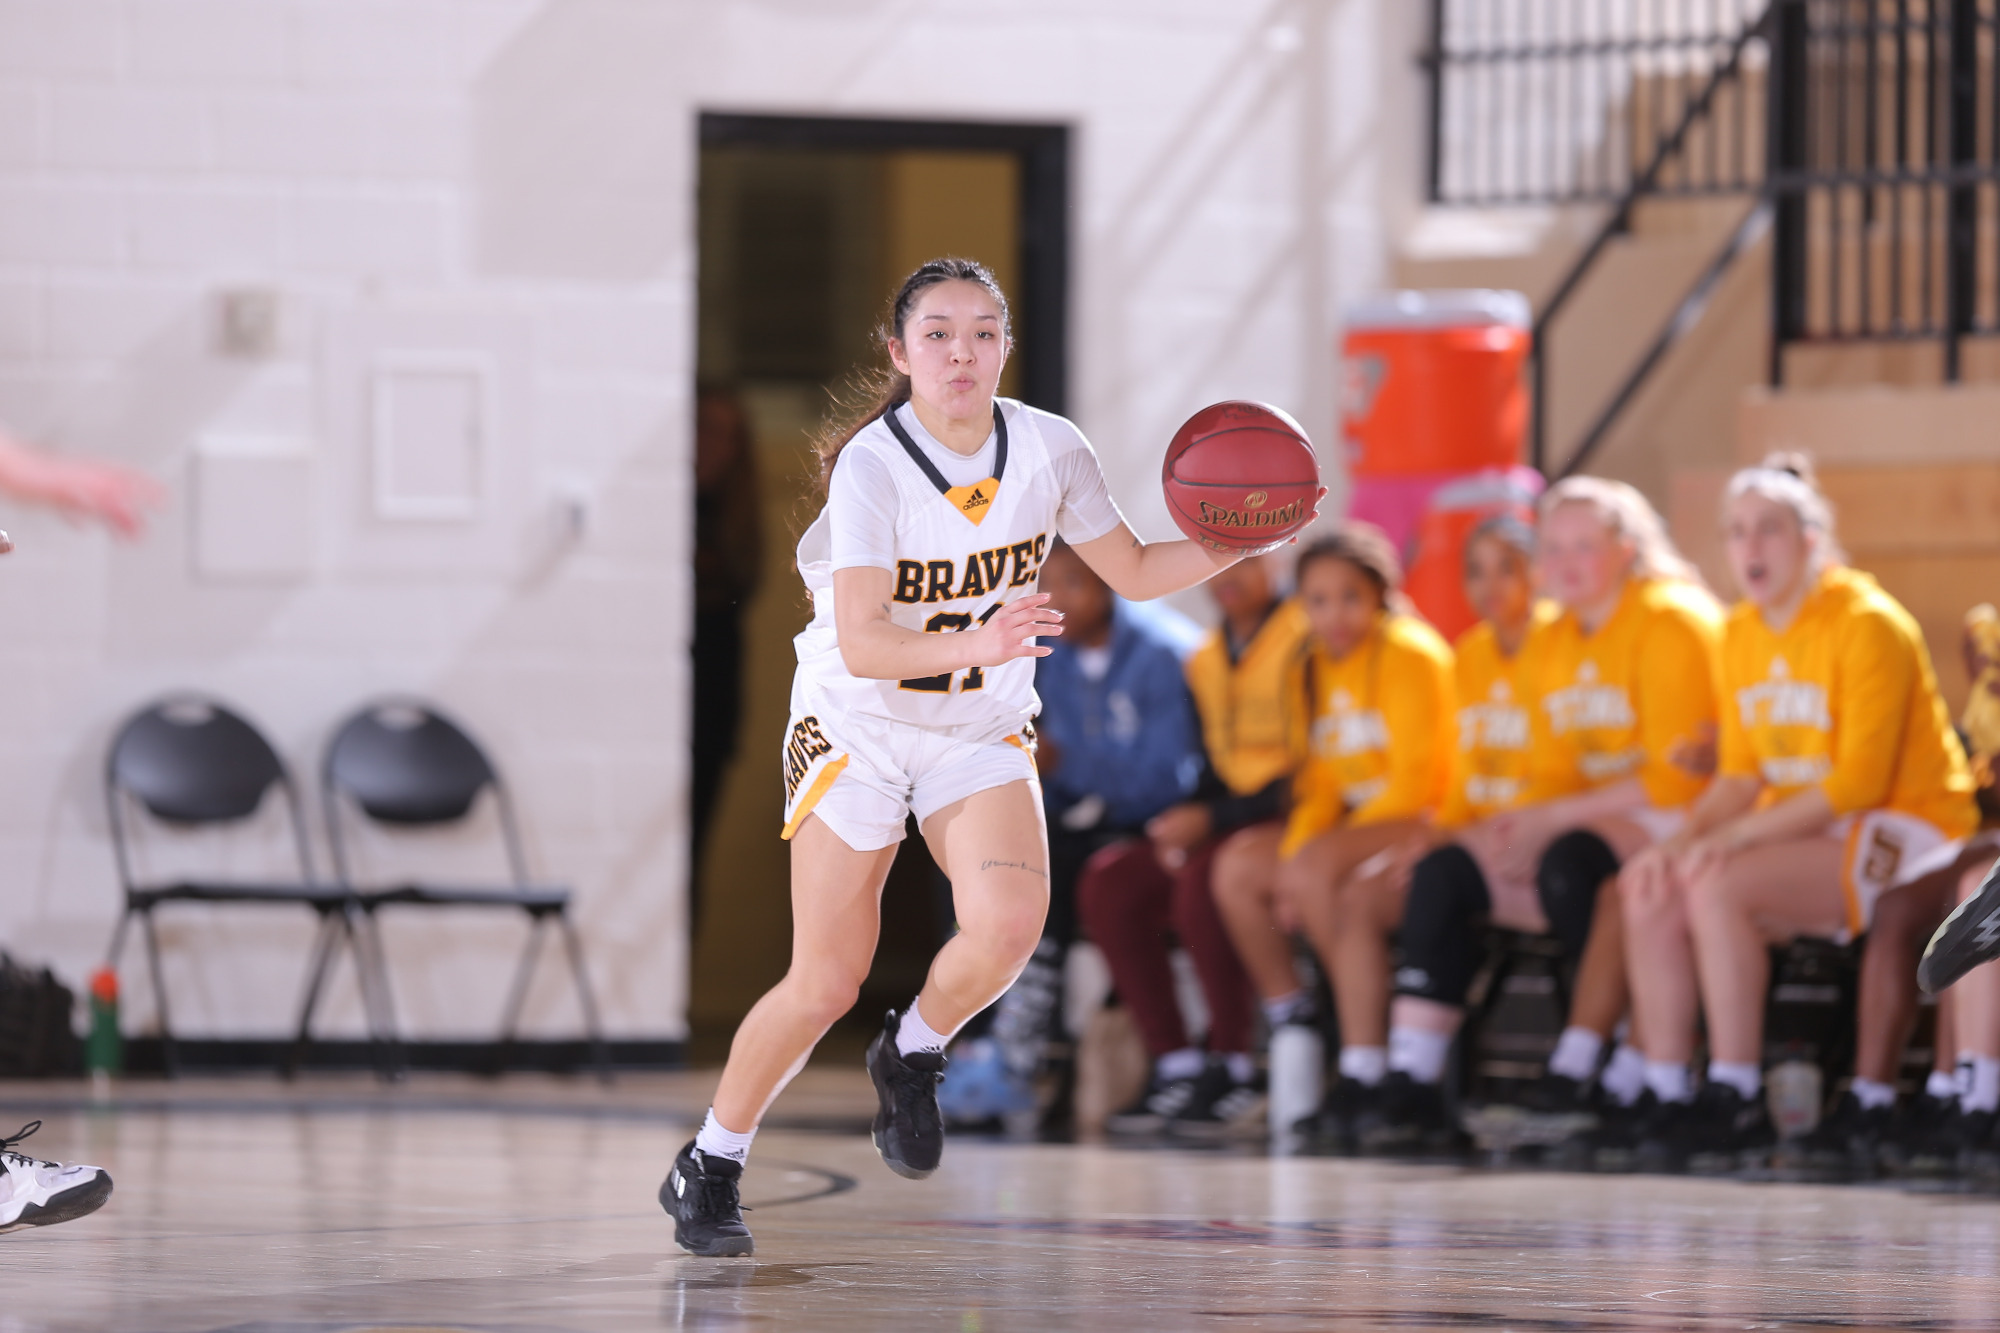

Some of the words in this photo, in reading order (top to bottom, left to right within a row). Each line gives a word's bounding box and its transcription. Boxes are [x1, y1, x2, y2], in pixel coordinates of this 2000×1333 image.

[962, 498, 989, 511] adidas
[1198, 497, 1305, 527] SPALDING
[892, 532, 1046, 605] BRAVES
[785, 715, 834, 809] RAVES
